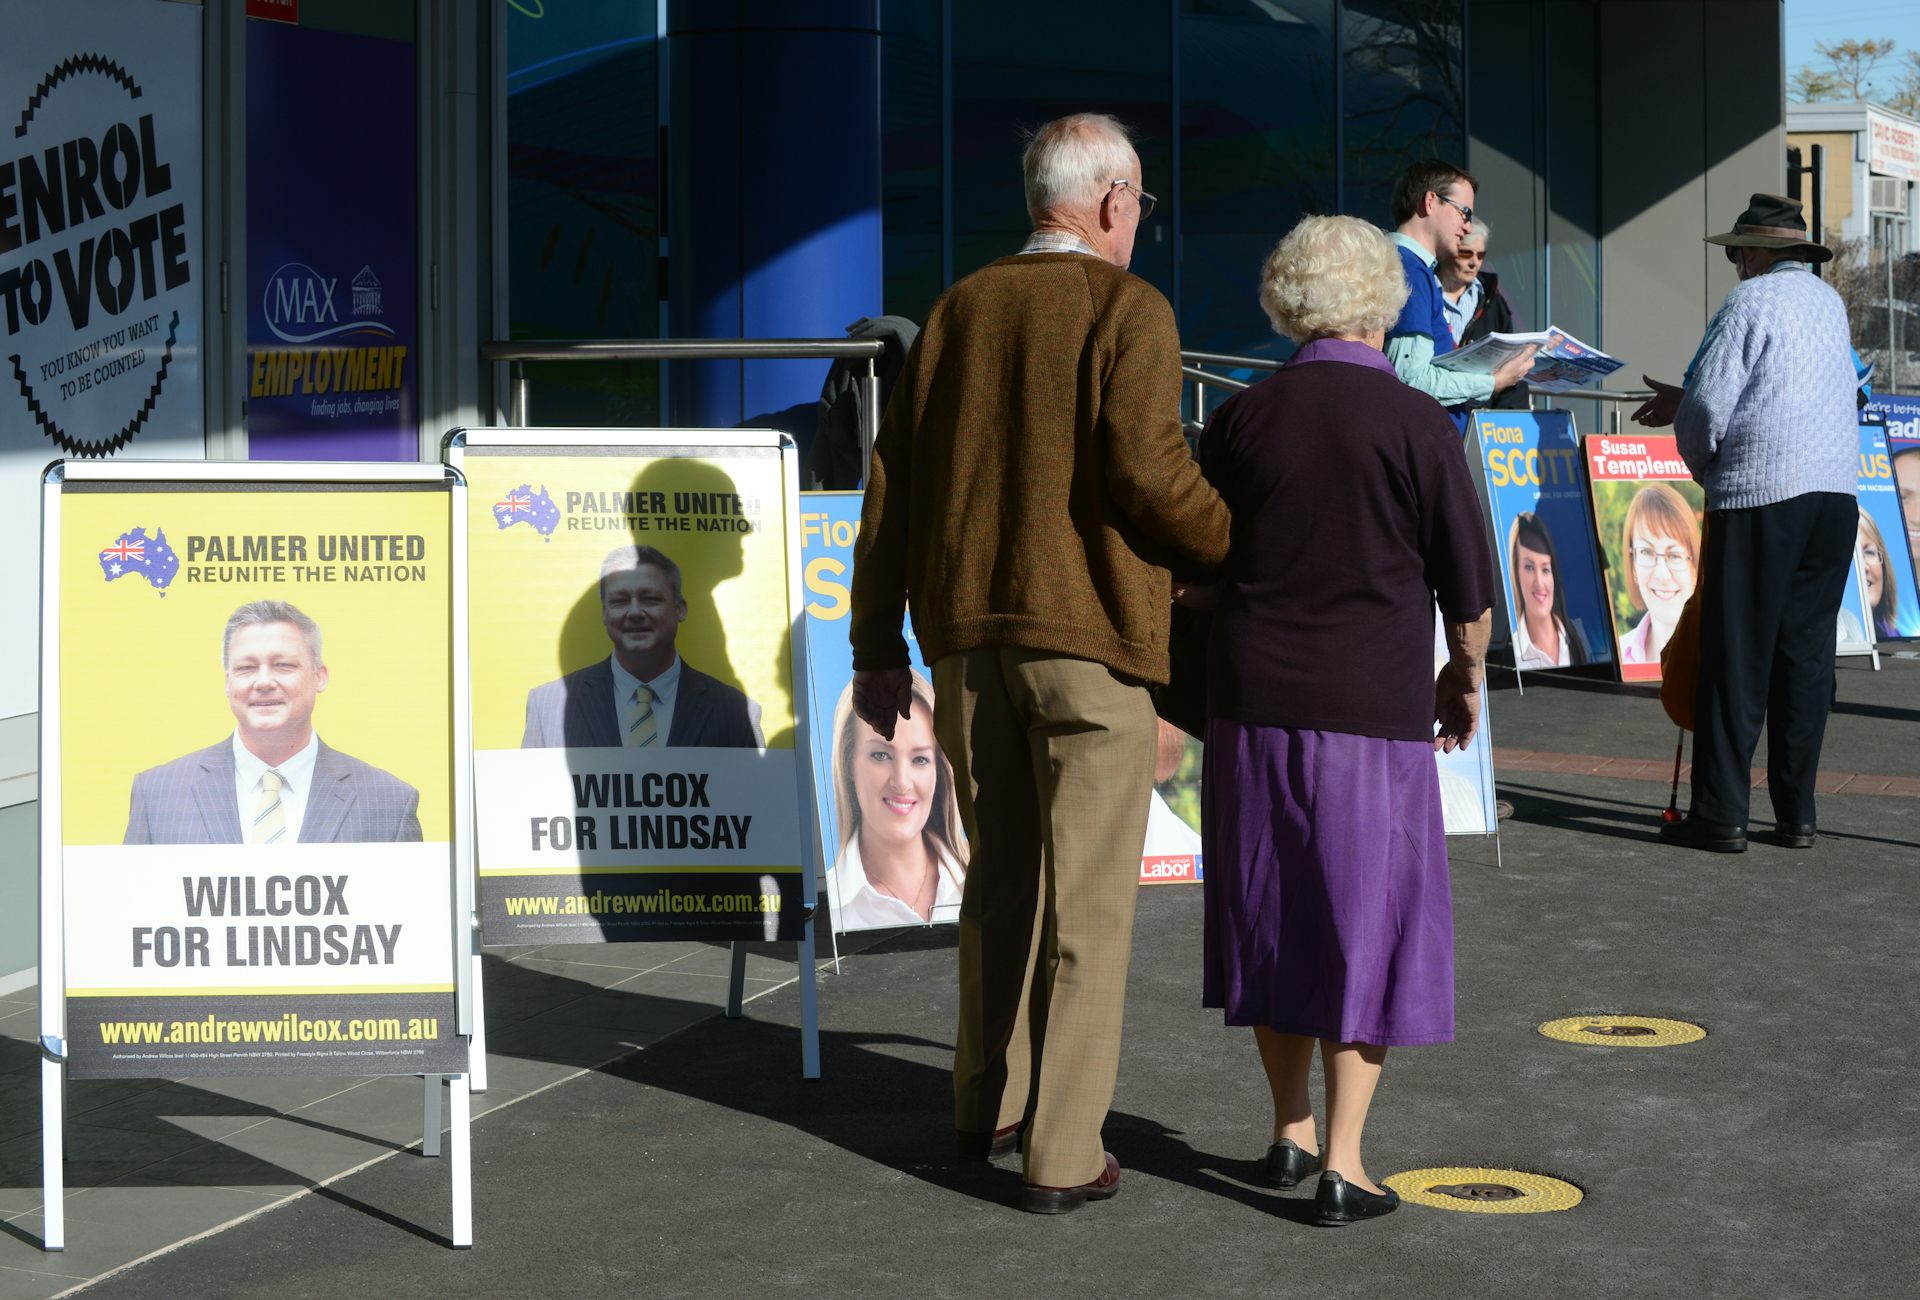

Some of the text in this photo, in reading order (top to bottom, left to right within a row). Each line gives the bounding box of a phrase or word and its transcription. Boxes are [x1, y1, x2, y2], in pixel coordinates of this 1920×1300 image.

[0, 113, 172, 255] ENROL
[0, 203, 190, 336] TO VOTE
[273, 277, 339, 324] MAX
[40, 314, 160, 382] YOU KNOW YOU WANT
[60, 348, 147, 401] TO BE COUNTED
[250, 346, 408, 397] EMPLOYMENT
[311, 399, 336, 418] finding
[353, 396, 384, 415] changing
[384, 394, 400, 410] lives
[1482, 422, 1524, 445] Fiona
[1601, 439, 1647, 455] Susan
[1488, 447, 1578, 487] SCOTT
[1857, 452, 1892, 479] US
[566, 491, 762, 516] PALMER UNITED
[567, 516, 762, 533] REUNITE THE NATION
[187, 535, 425, 561] PALMER UNITED
[187, 565, 427, 582] REUNITE THE NATION
[572, 773, 710, 808] WILCOX
[530, 815, 752, 851] FOR LINDSAY
[1141, 860, 1191, 878] Labor
[182, 875, 350, 917] WILCOX
[505, 889, 781, 916] www.andrewwilcox.com.au
[132, 924, 403, 968] FOR LINDSAY
[100, 1013, 438, 1044] www.andrewwilcox.com.au
